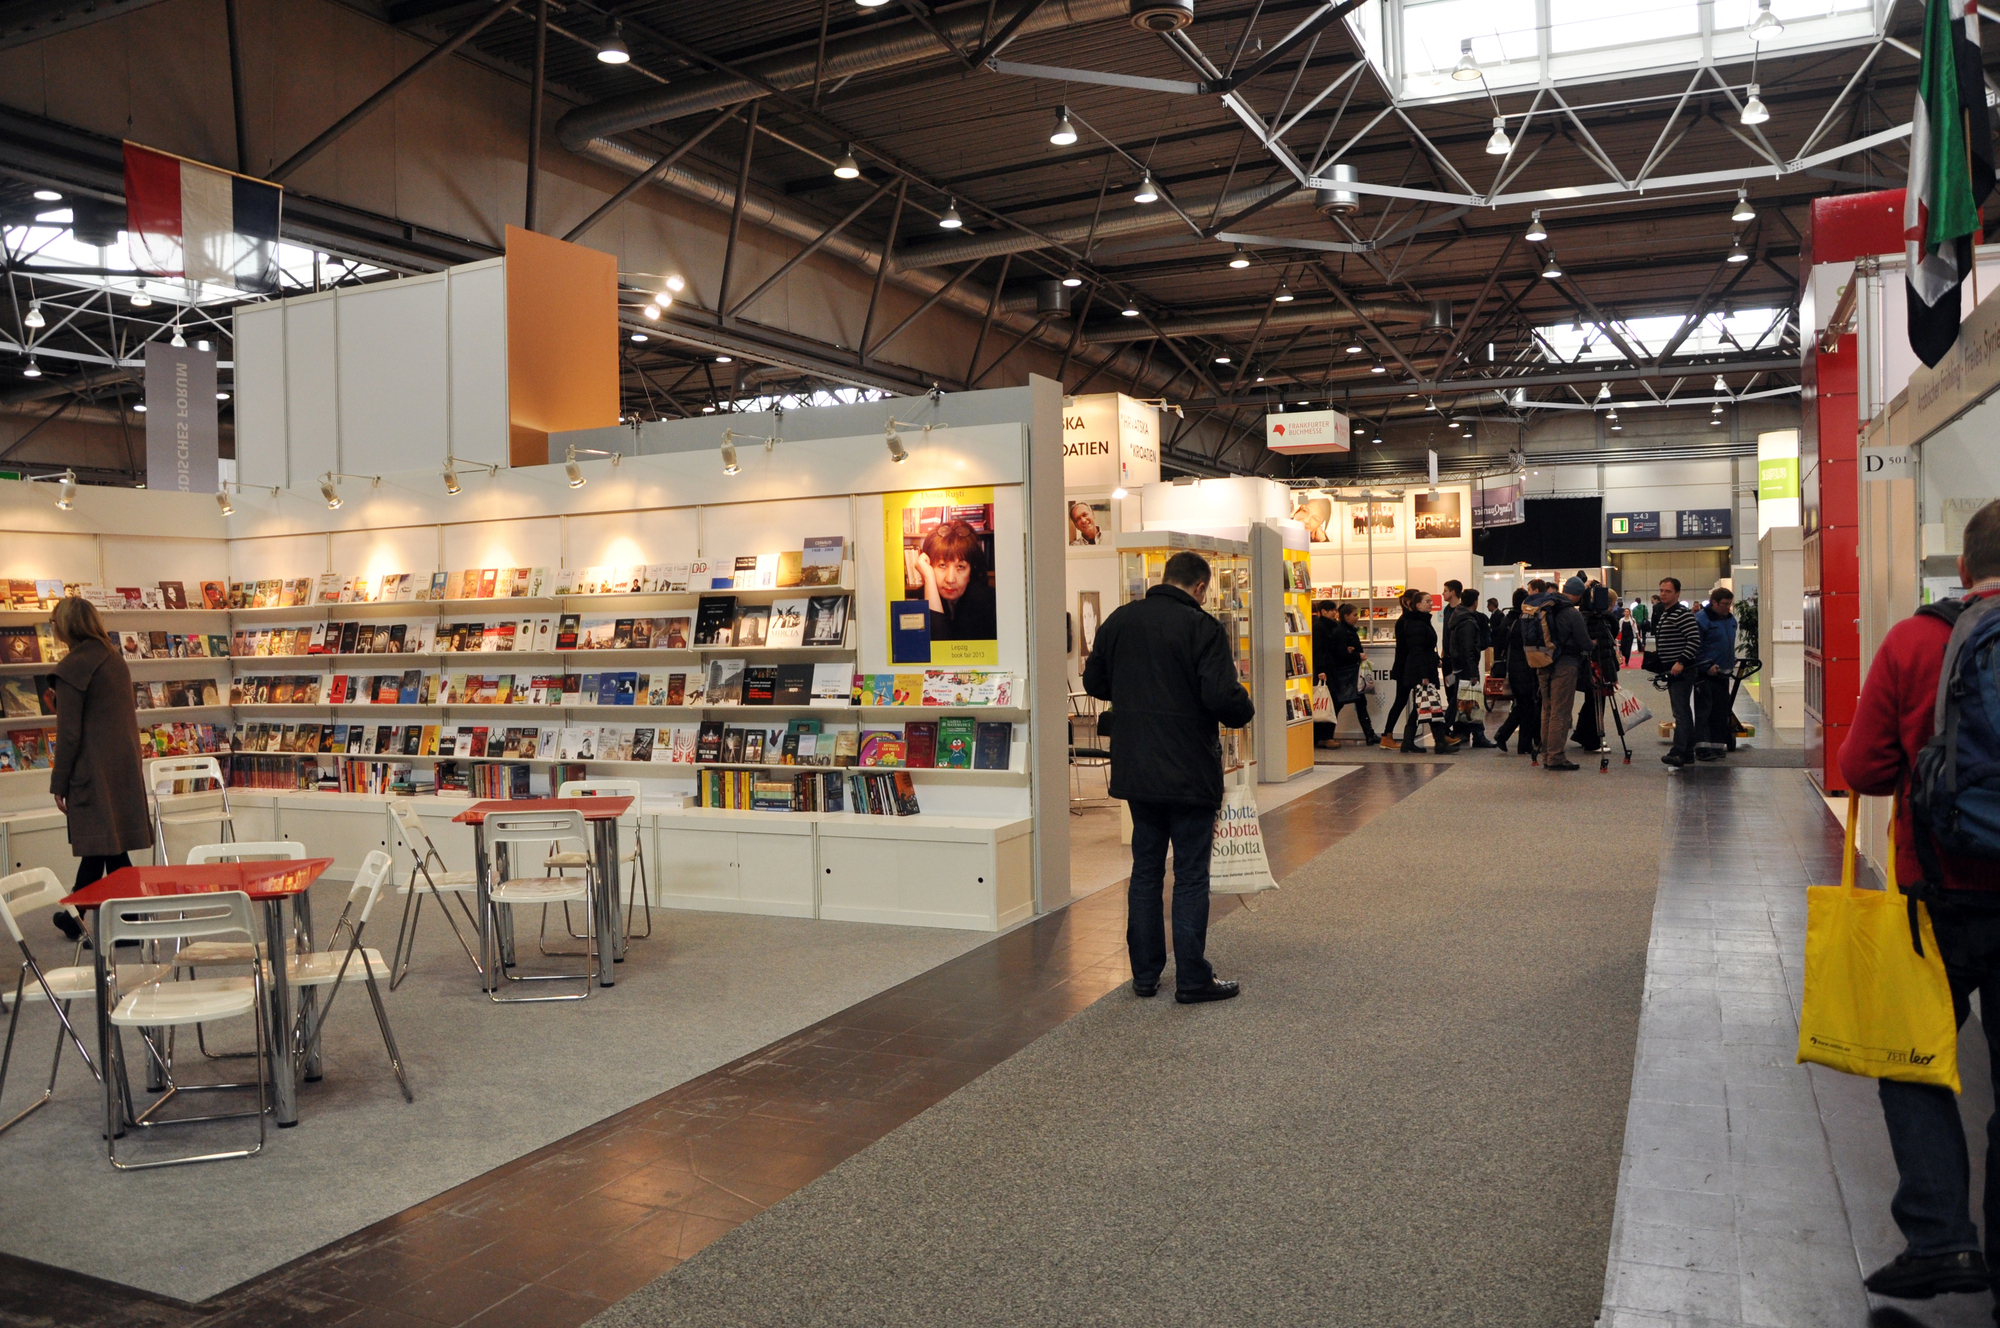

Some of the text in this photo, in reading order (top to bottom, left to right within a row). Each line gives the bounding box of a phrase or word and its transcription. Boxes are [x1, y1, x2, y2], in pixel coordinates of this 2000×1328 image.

[1063, 416, 1085, 430] KA
[1289, 421, 1330, 429] FRANKFURTER
[1289, 428, 1322, 436] BUCHMESSE
[1865, 455, 1907, 472] D 501
[951, 643, 968, 652] Leipzig
[1213, 822, 1259, 839] Sobotta
[1212, 840, 1261, 857] Sobotta
[1909, 1047, 1936, 1065] leo
